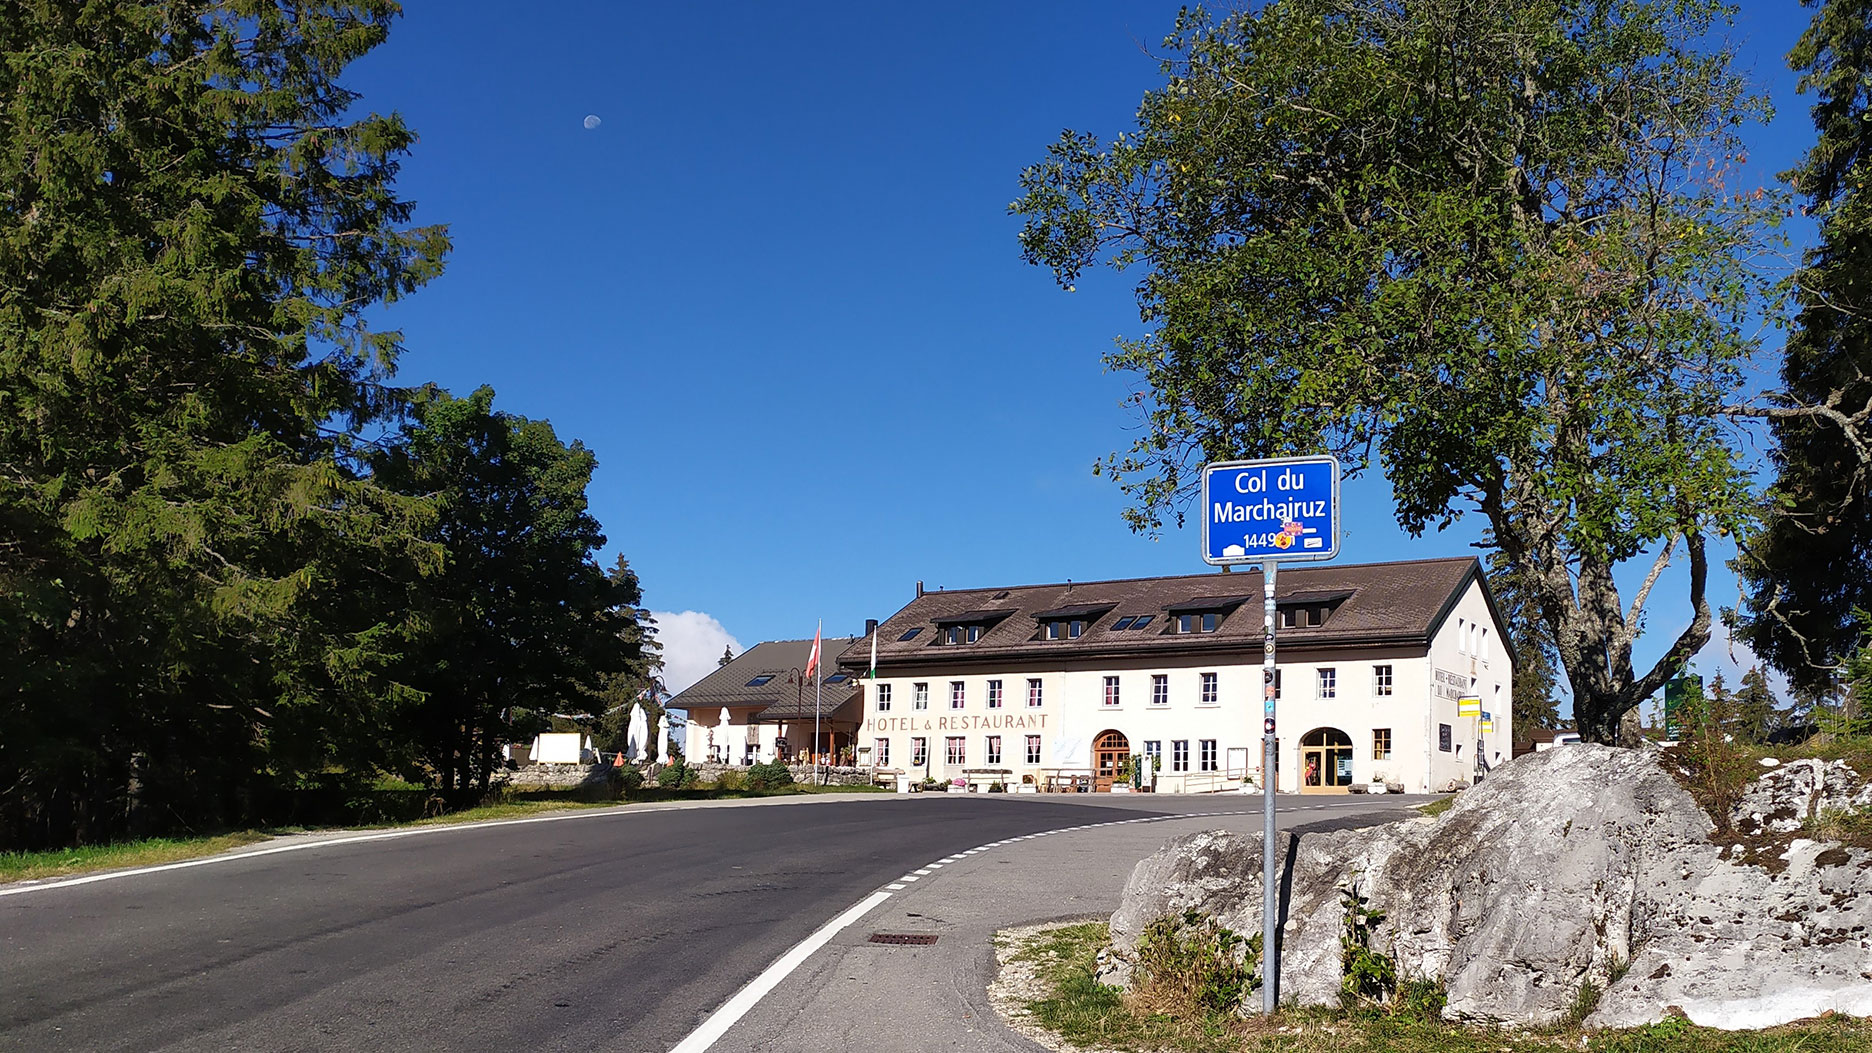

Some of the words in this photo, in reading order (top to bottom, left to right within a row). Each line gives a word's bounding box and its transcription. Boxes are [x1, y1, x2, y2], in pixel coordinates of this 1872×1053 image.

[1235, 469, 1266, 494] Col
[1277, 467, 1304, 490] du
[1214, 496, 1326, 523] Marchairuz
[1243, 532, 1276, 549] 1449
[867, 717, 919, 731] HOTEL
[924, 719, 932, 730] &
[938, 714, 1049, 730] RESTAURANT
